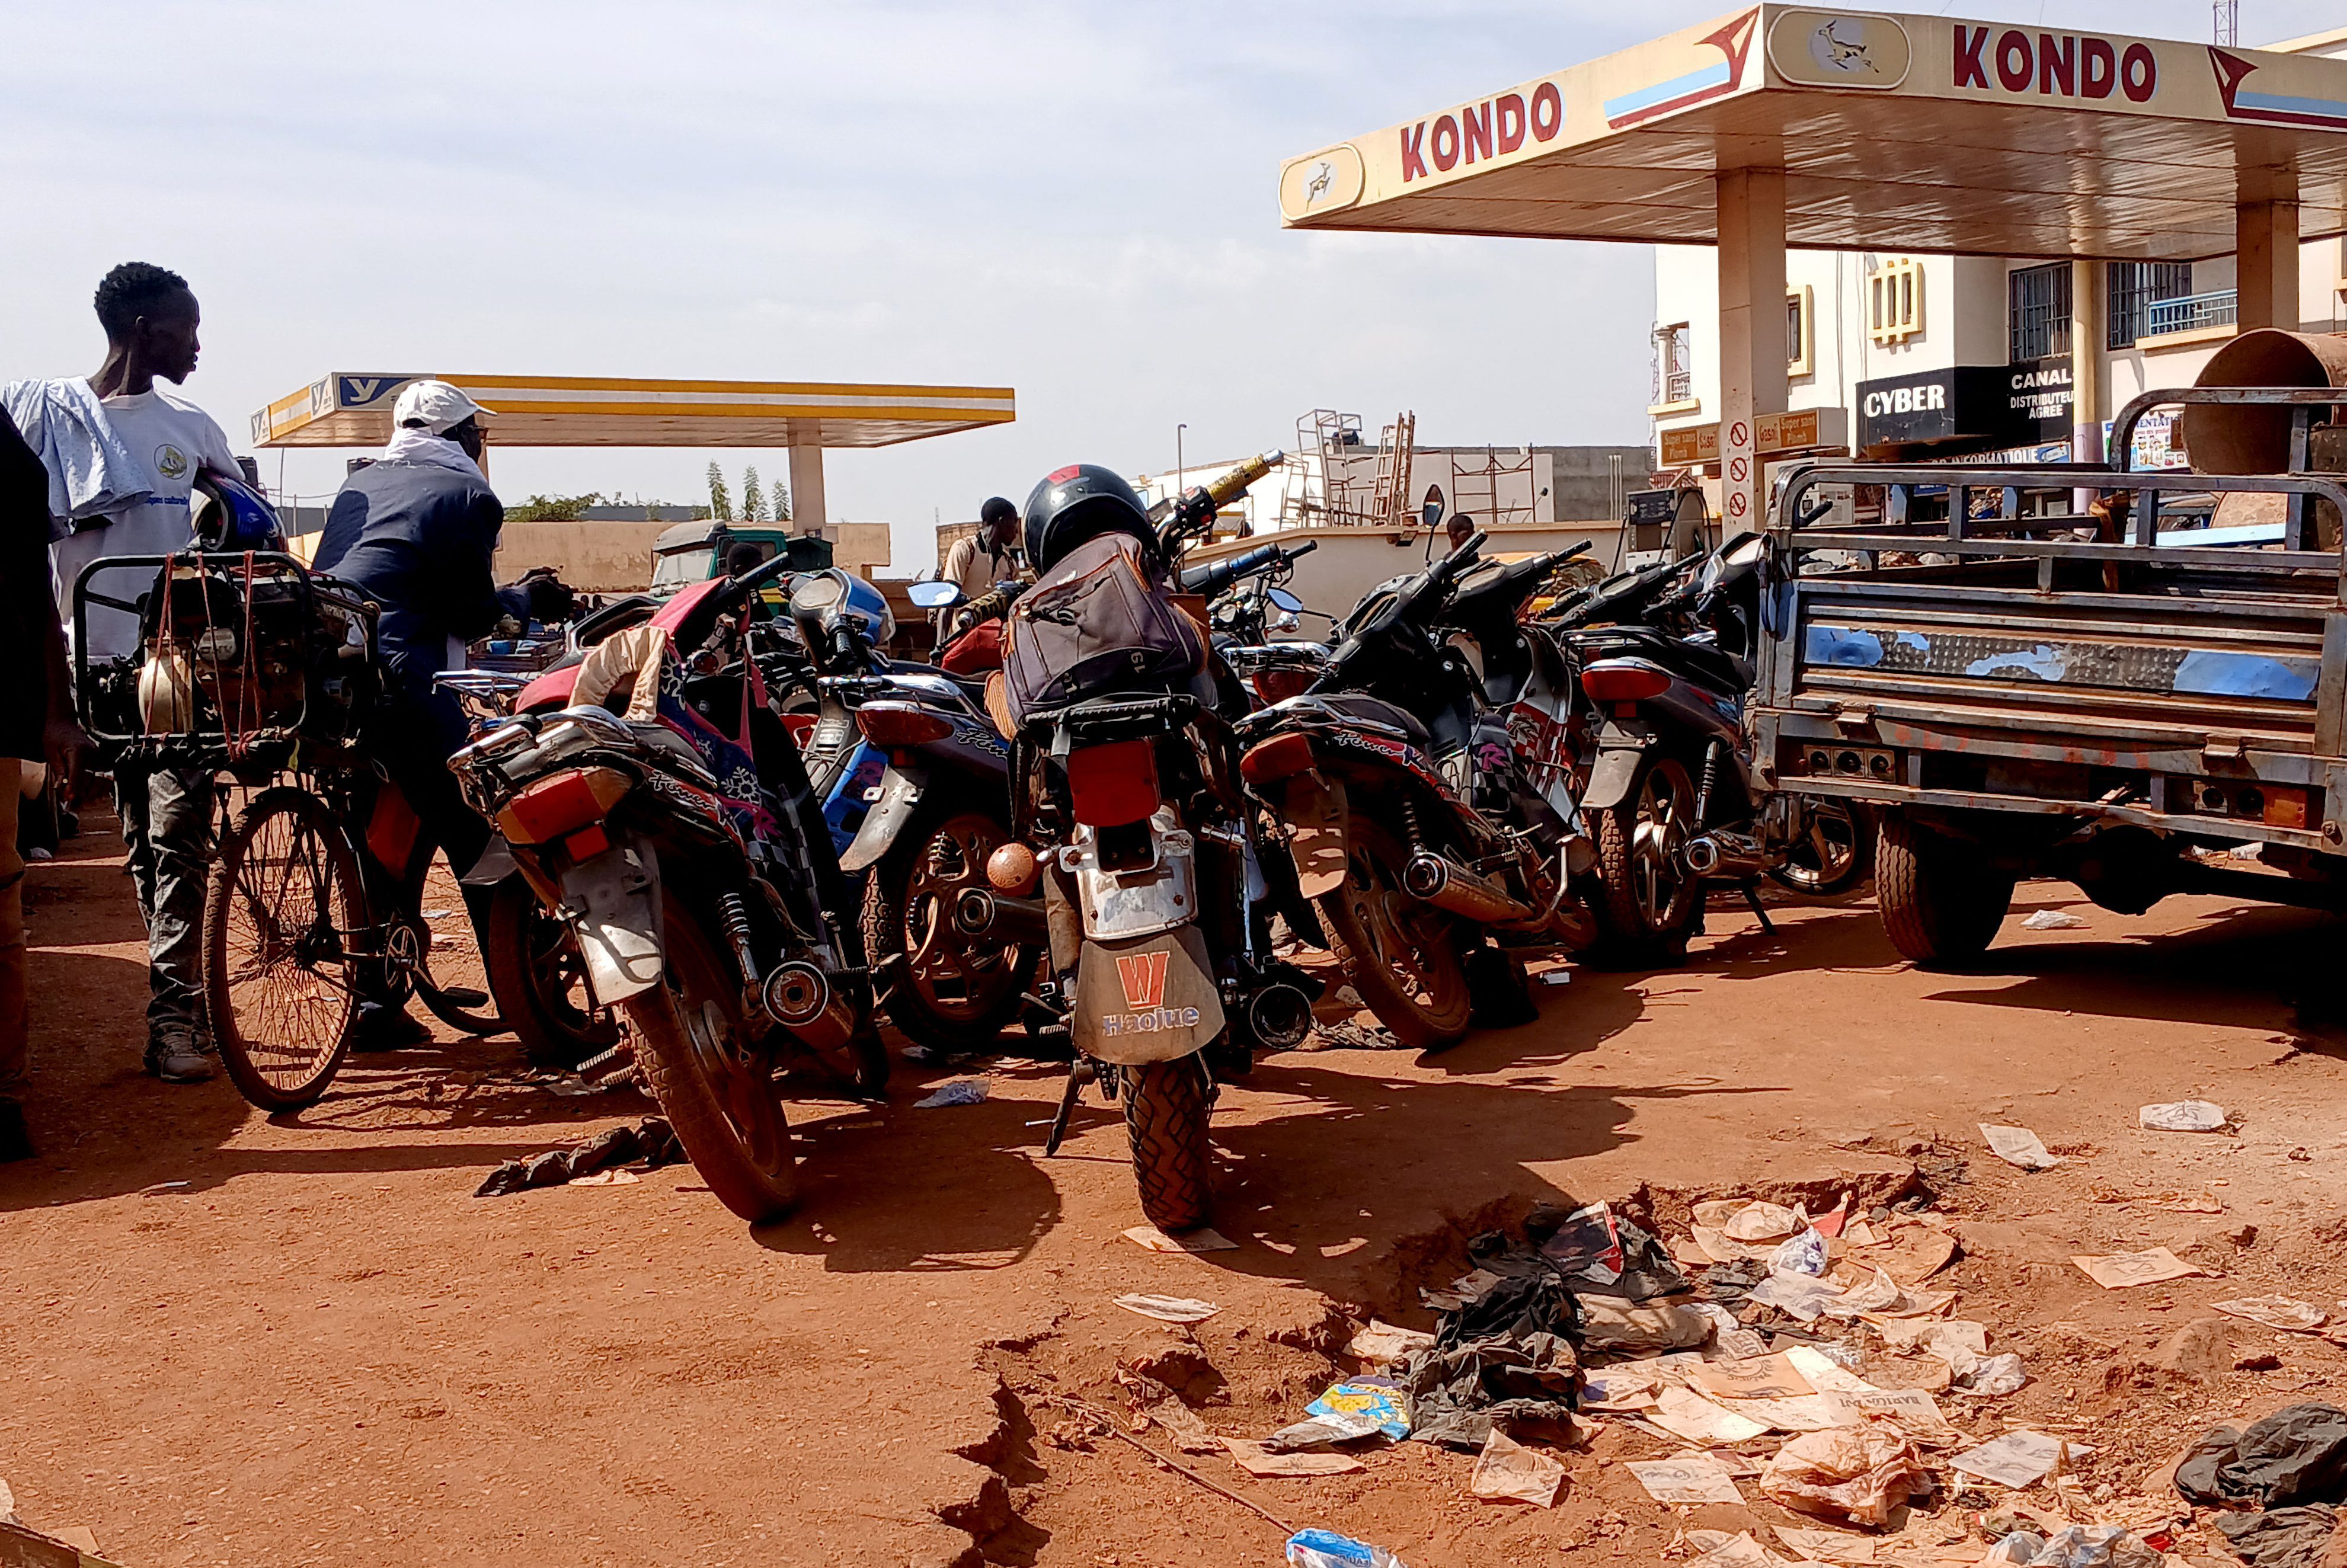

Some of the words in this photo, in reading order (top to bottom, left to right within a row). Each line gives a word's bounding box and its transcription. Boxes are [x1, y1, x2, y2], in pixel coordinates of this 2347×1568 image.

[1953, 25, 2156, 103] KONDO
[1400, 82, 1563, 182] KONDO
[2012, 368, 2073, 389] CANAL
[1865, 385, 1945, 417] CYBER
[2010, 391, 2074, 408] DISTRIBUTEU
[1103, 1007, 1200, 1036] Haojue
